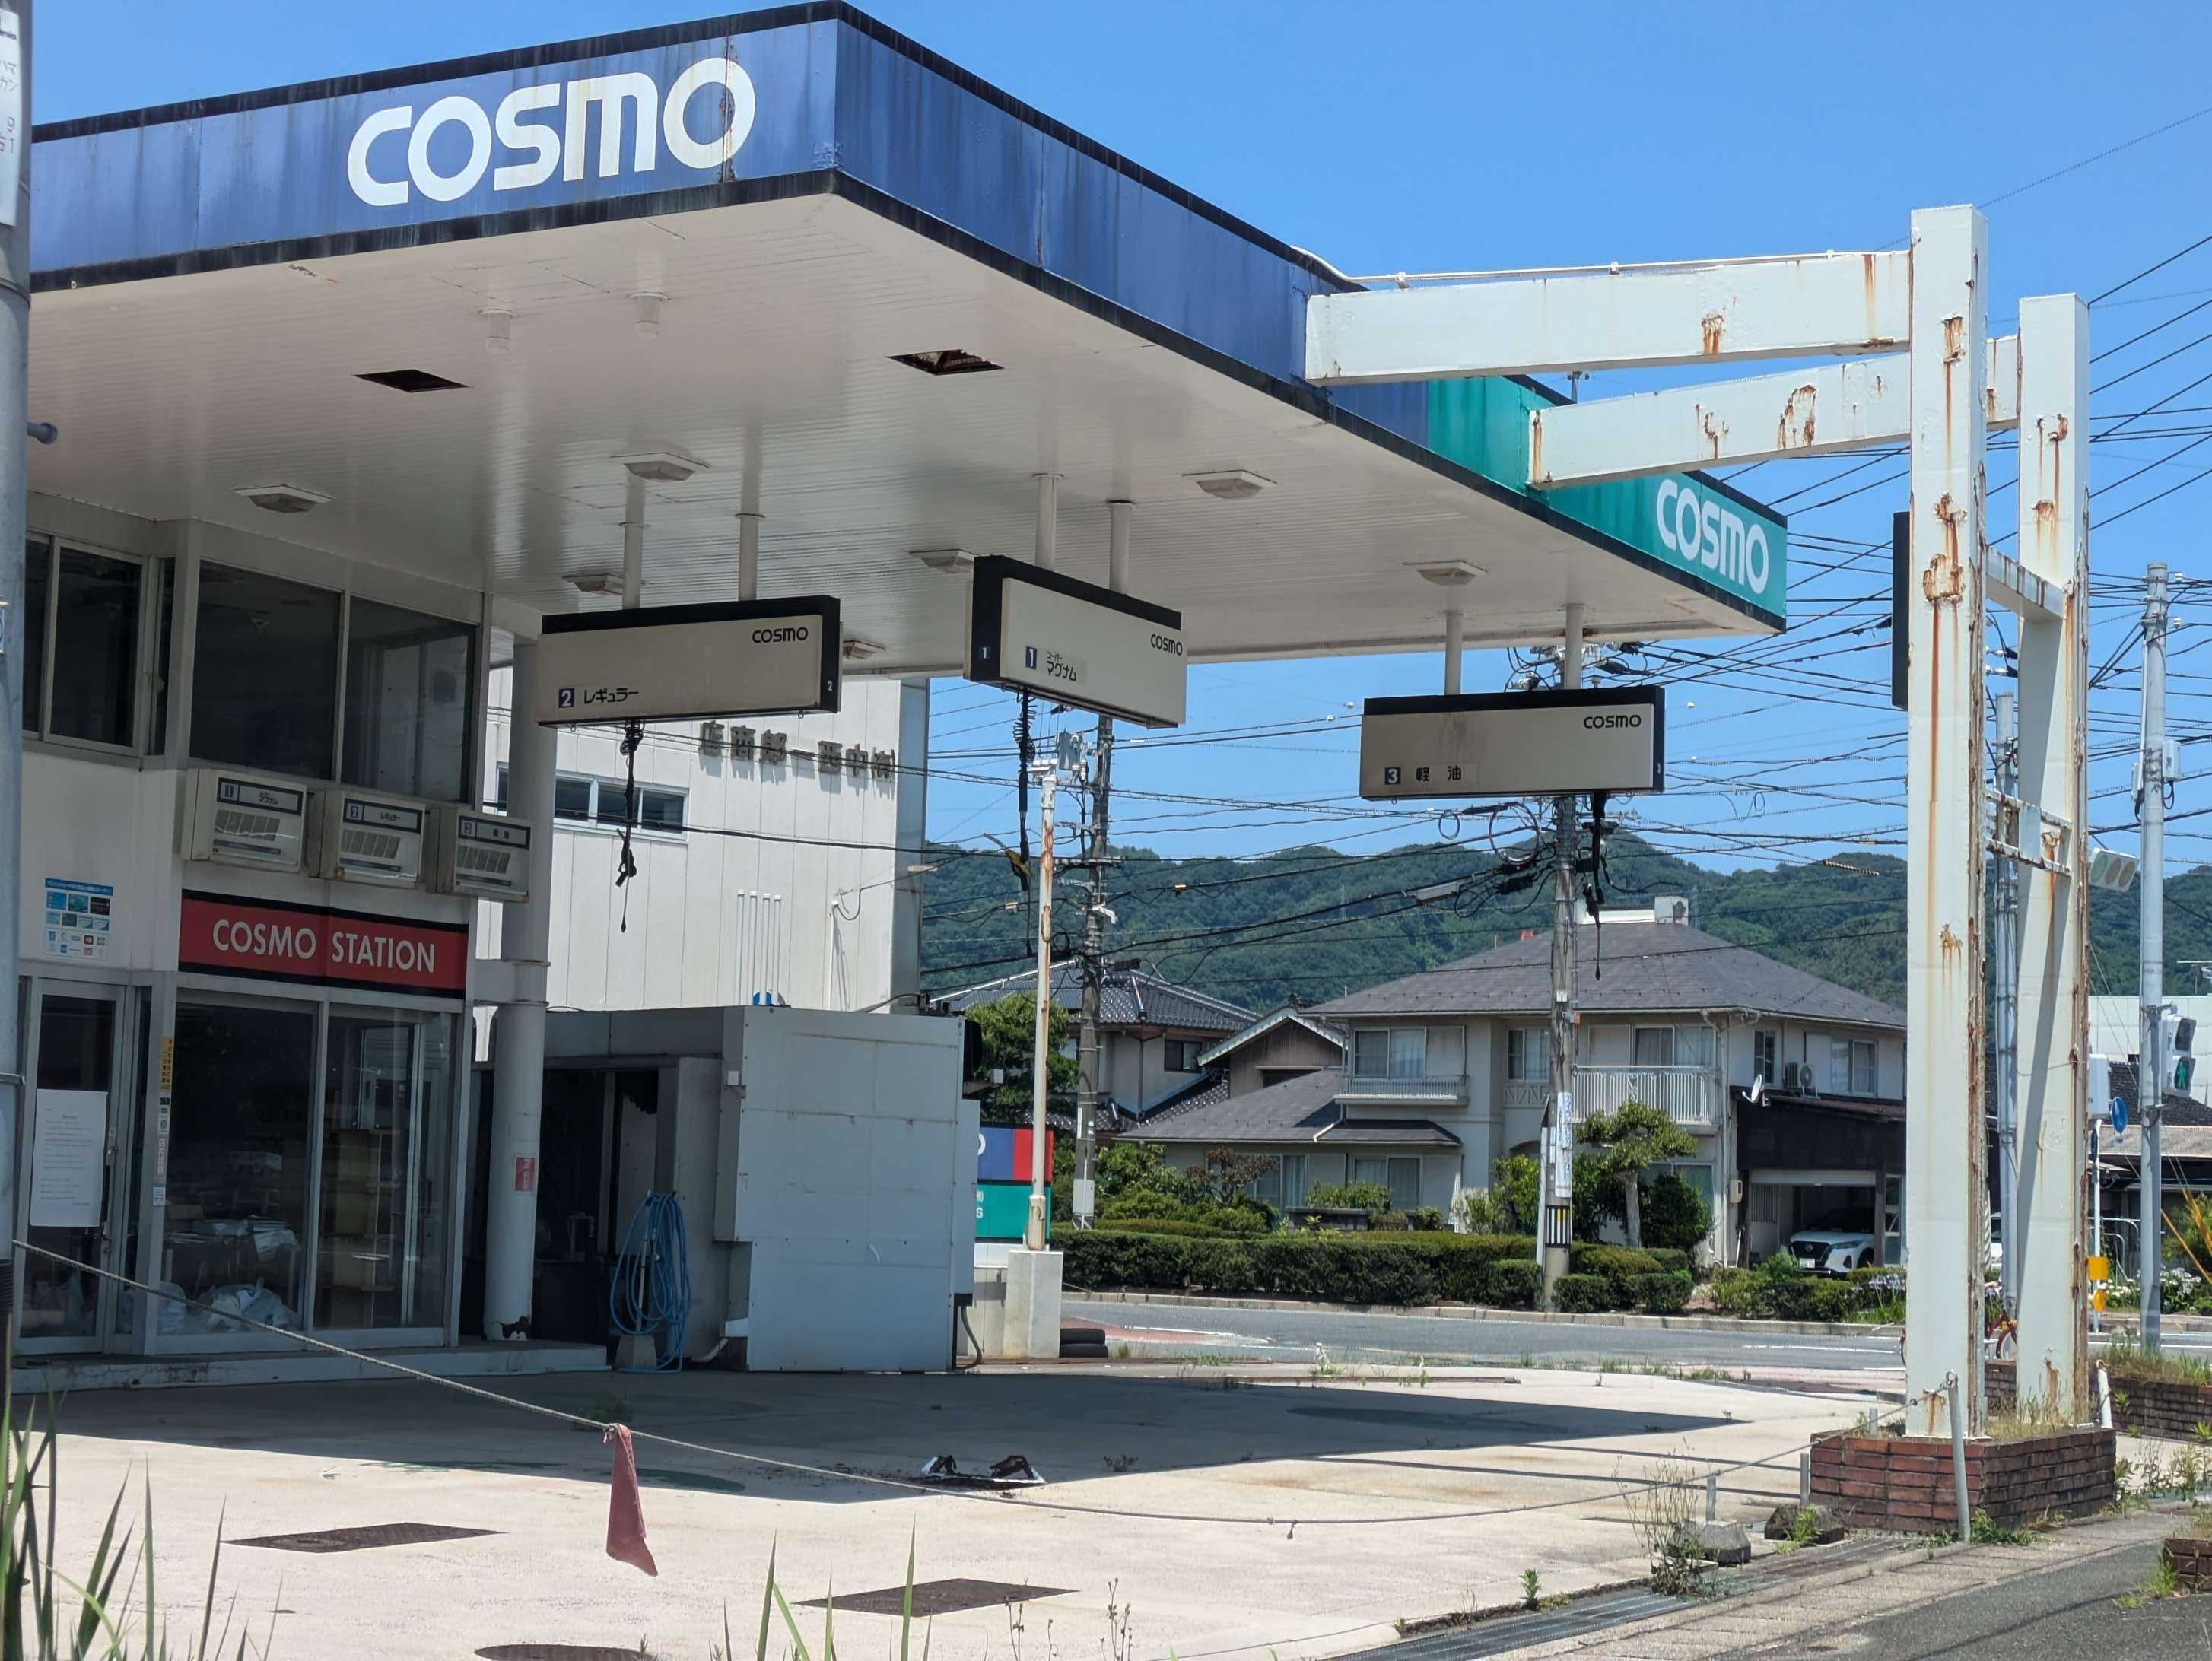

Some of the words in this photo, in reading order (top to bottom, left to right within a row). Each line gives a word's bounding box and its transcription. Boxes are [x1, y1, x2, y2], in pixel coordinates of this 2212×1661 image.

[348, 57, 755, 206] COSMO
[1657, 479, 1769, 594] COSMO
[752, 627, 809, 643] COSMO
[1150, 634, 1183, 656] COSMO
[1047, 660, 1077, 681] マグナム
[827, 680, 833, 692] 2
[561, 689, 573, 707] 2
[583, 688, 639, 704] レギュラー
[1583, 714, 1642, 729] COSMO
[1387, 767, 1399, 784] 3
[213, 919, 316, 959] COSMO
[332, 932, 434, 973] STATION
